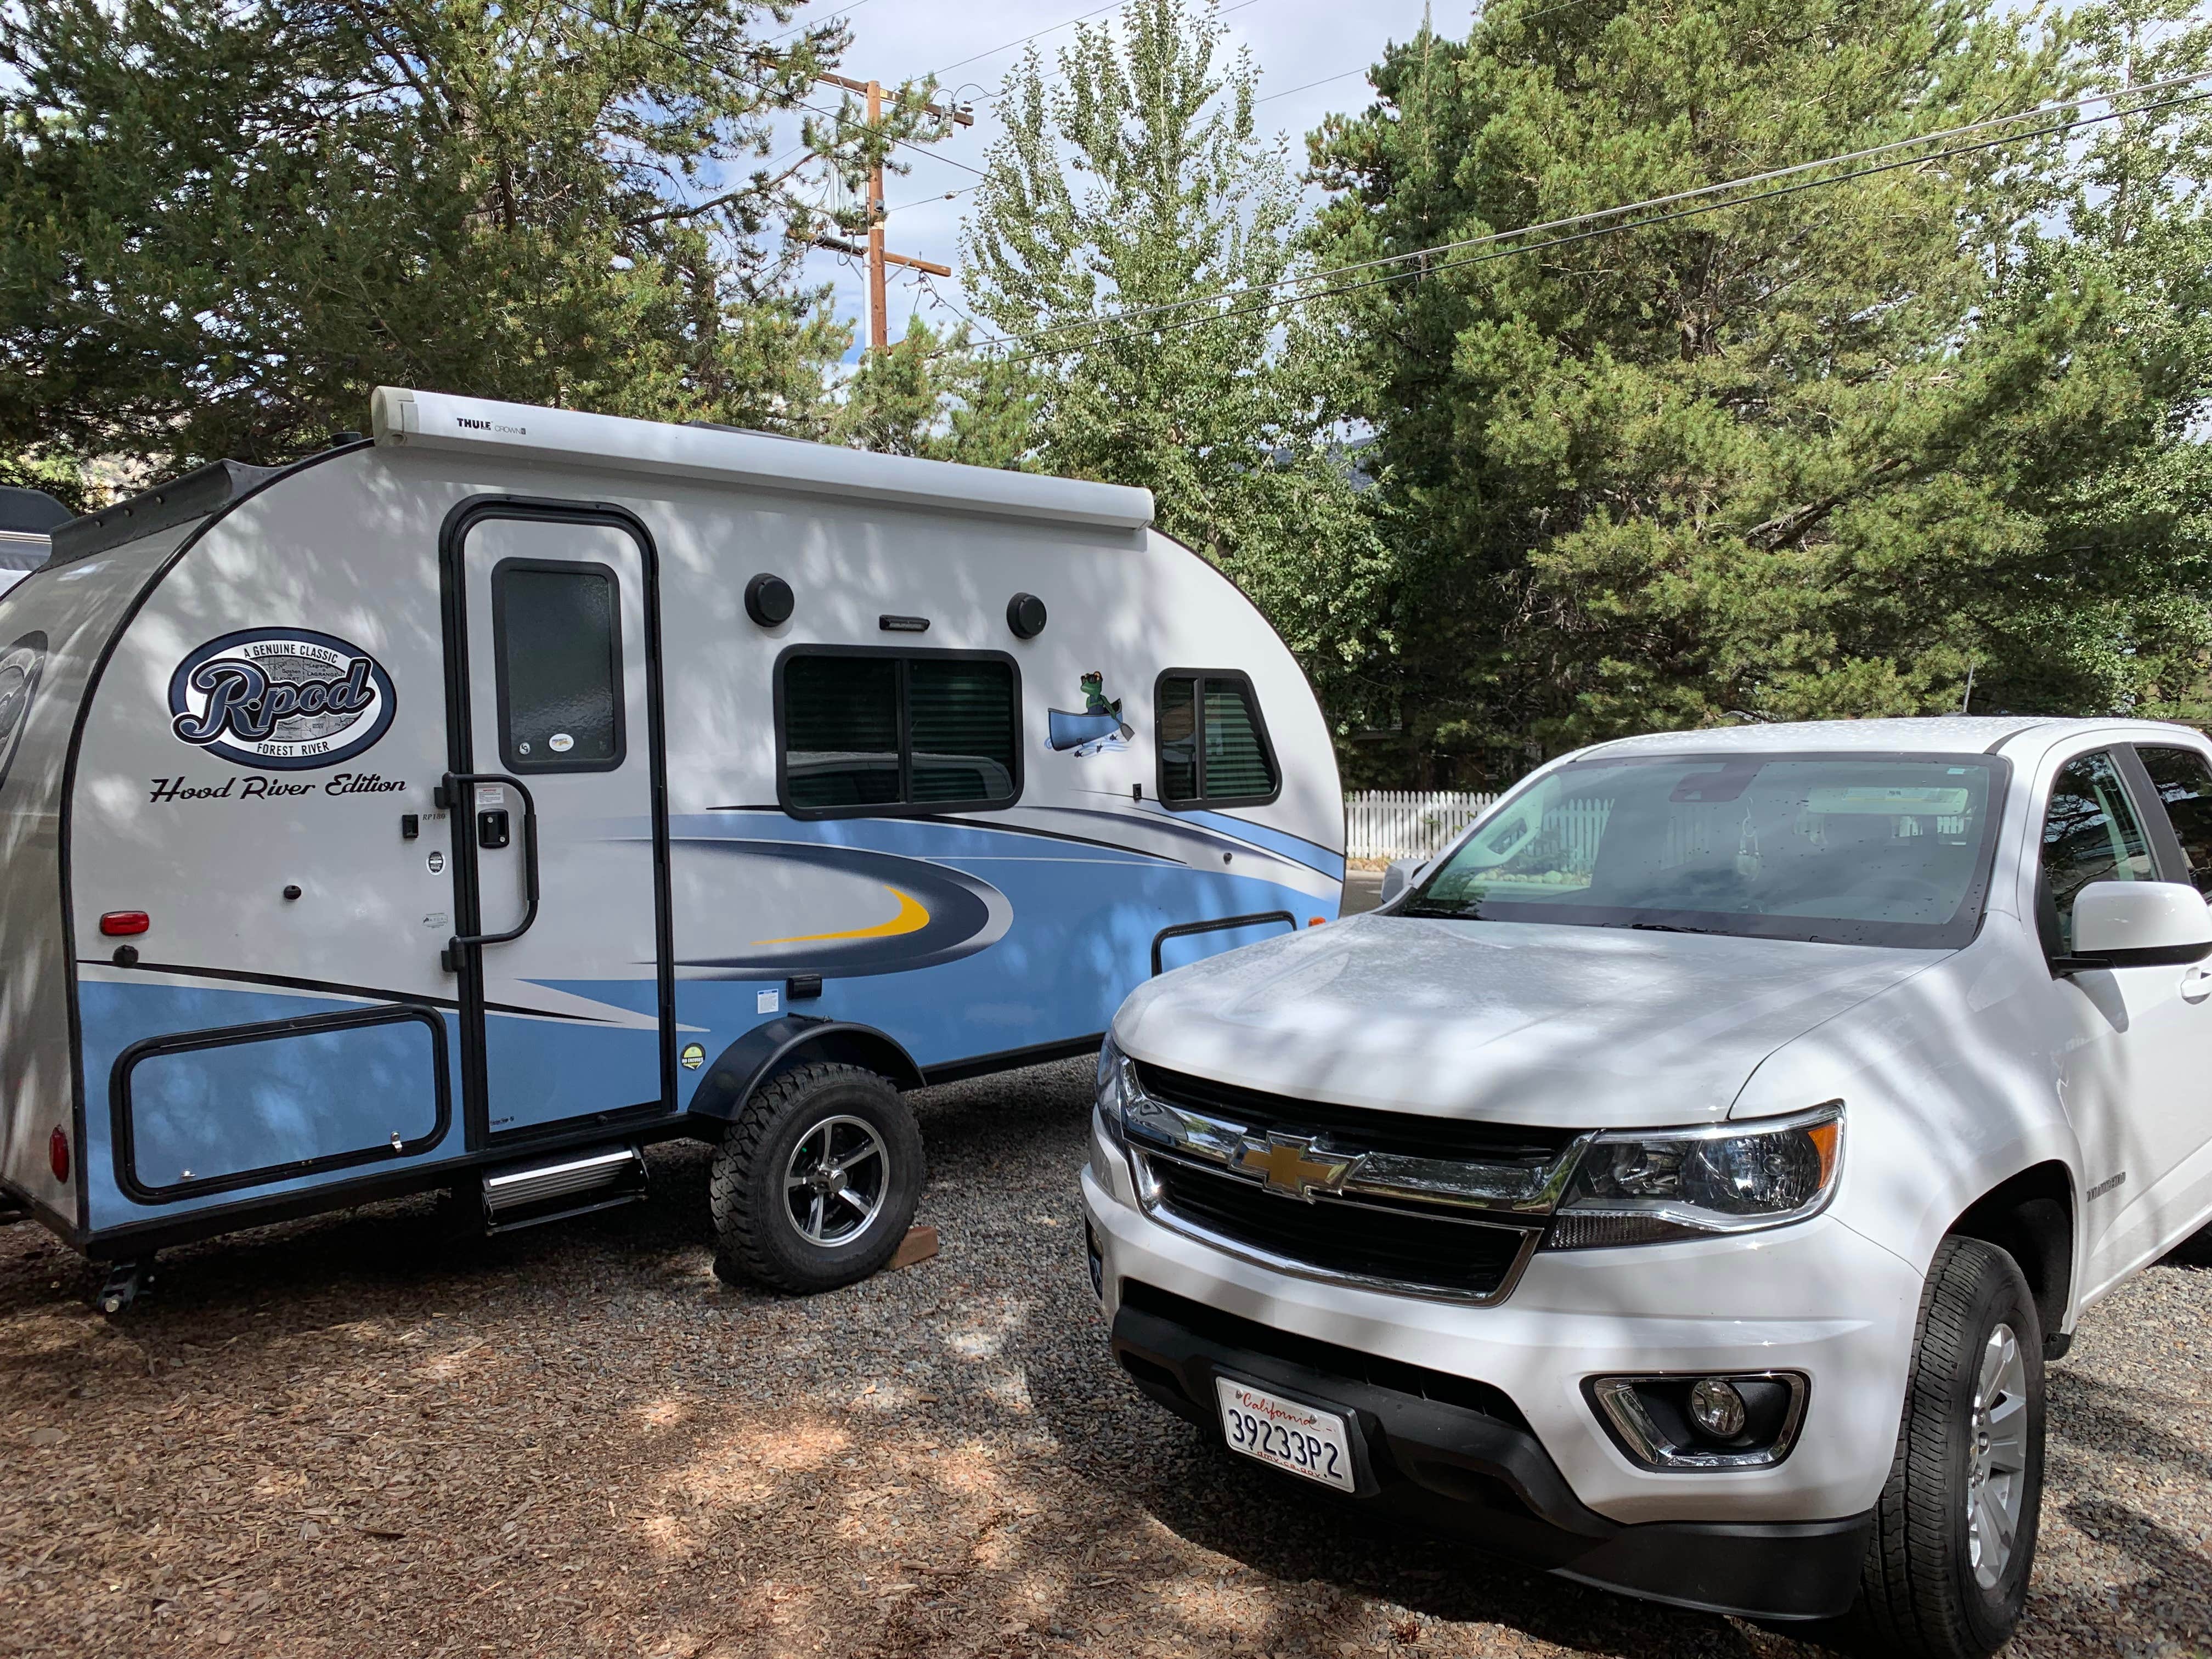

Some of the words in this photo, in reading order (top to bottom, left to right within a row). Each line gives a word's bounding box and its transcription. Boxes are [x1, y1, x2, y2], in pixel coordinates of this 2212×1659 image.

[457, 417, 491, 430] THULE
[494, 425, 521, 435] CROWN
[244, 648, 251, 658] A
[253, 644, 295, 656] GENUINE
[300, 646, 338, 663] CLASSIC
[257, 743, 294, 755] FOREST
[302, 742, 330, 755] RIVER
[150, 776, 236, 802] Hood
[240, 776, 315, 799] River
[325, 774, 407, 795] Edition
[1243, 1393, 1320, 1431] California
[1228, 1409, 1342, 1479] 39233P2
[1257, 1451, 1321, 1478] dmv.ca.gov
